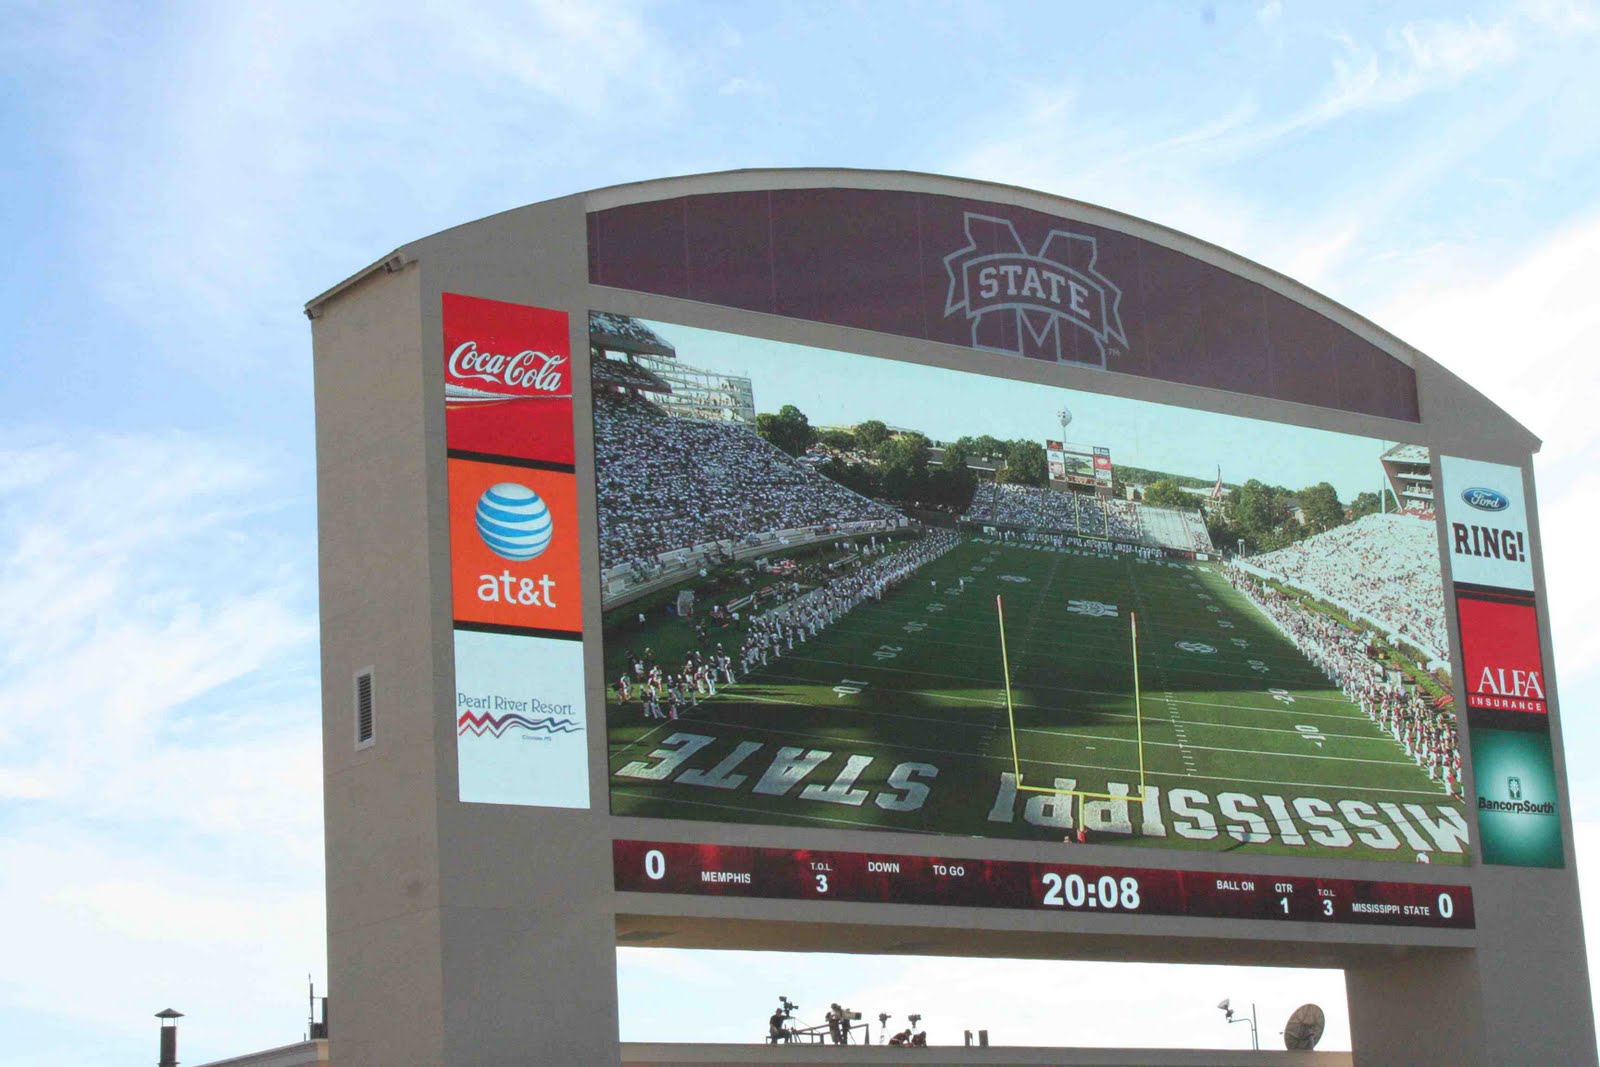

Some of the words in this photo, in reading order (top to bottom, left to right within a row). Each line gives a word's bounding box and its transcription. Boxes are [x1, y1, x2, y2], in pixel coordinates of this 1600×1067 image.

[978, 264, 1090, 320] STATE
[1471, 489, 1501, 508] Ford
[1452, 522, 1526, 563] RING!
[477, 570, 557, 608] at&t
[1477, 666, 1545, 699] ALFA
[457, 692, 492, 710] Pearl
[494, 695, 528, 713] River
[1471, 697, 1543, 711] INSURANCE
[1478, 796, 1554, 815] BancorpSouth
[645, 850, 666, 880] 0
[701, 871, 751, 885] MEMPHIS
[867, 861, 900, 874] DOWN
[932, 864, 947, 876] TO
[949, 865, 965, 877] GO
[815, 874, 829, 893] 3
[1042, 872, 1140, 909] 20:08
[1216, 880, 1239, 891] BALL
[1241, 882, 1254, 892] ON
[1275, 883, 1293, 894] QTR
[1280, 897, 1289, 914] 1
[1323, 899, 1334, 916] 3
[1352, 902, 1401, 915] MISSISSIPPI
[1403, 904, 1431, 917] STATE
[1437, 893, 1454, 918] 0
